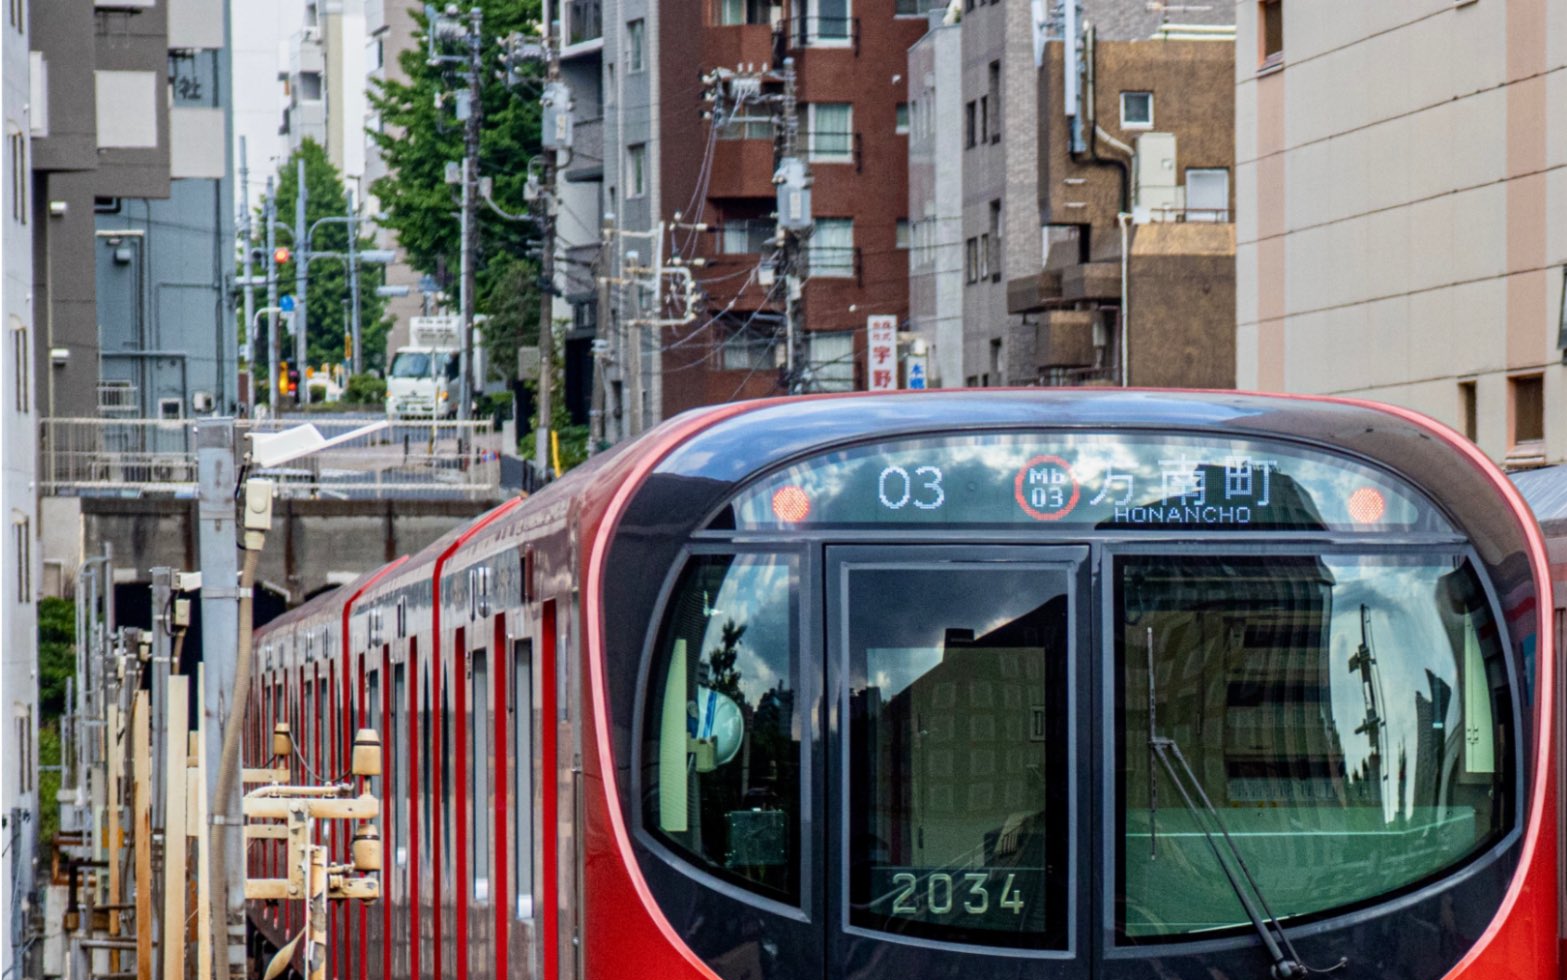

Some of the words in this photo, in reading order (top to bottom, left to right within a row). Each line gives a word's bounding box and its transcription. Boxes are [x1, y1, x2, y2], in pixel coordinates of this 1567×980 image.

[1029, 468, 1065, 485] Mb
[878, 466, 945, 509] 03
[1030, 487, 1064, 508] 03
[1113, 506, 1252, 524] HONANCHO
[892, 872, 1024, 914] 2034
